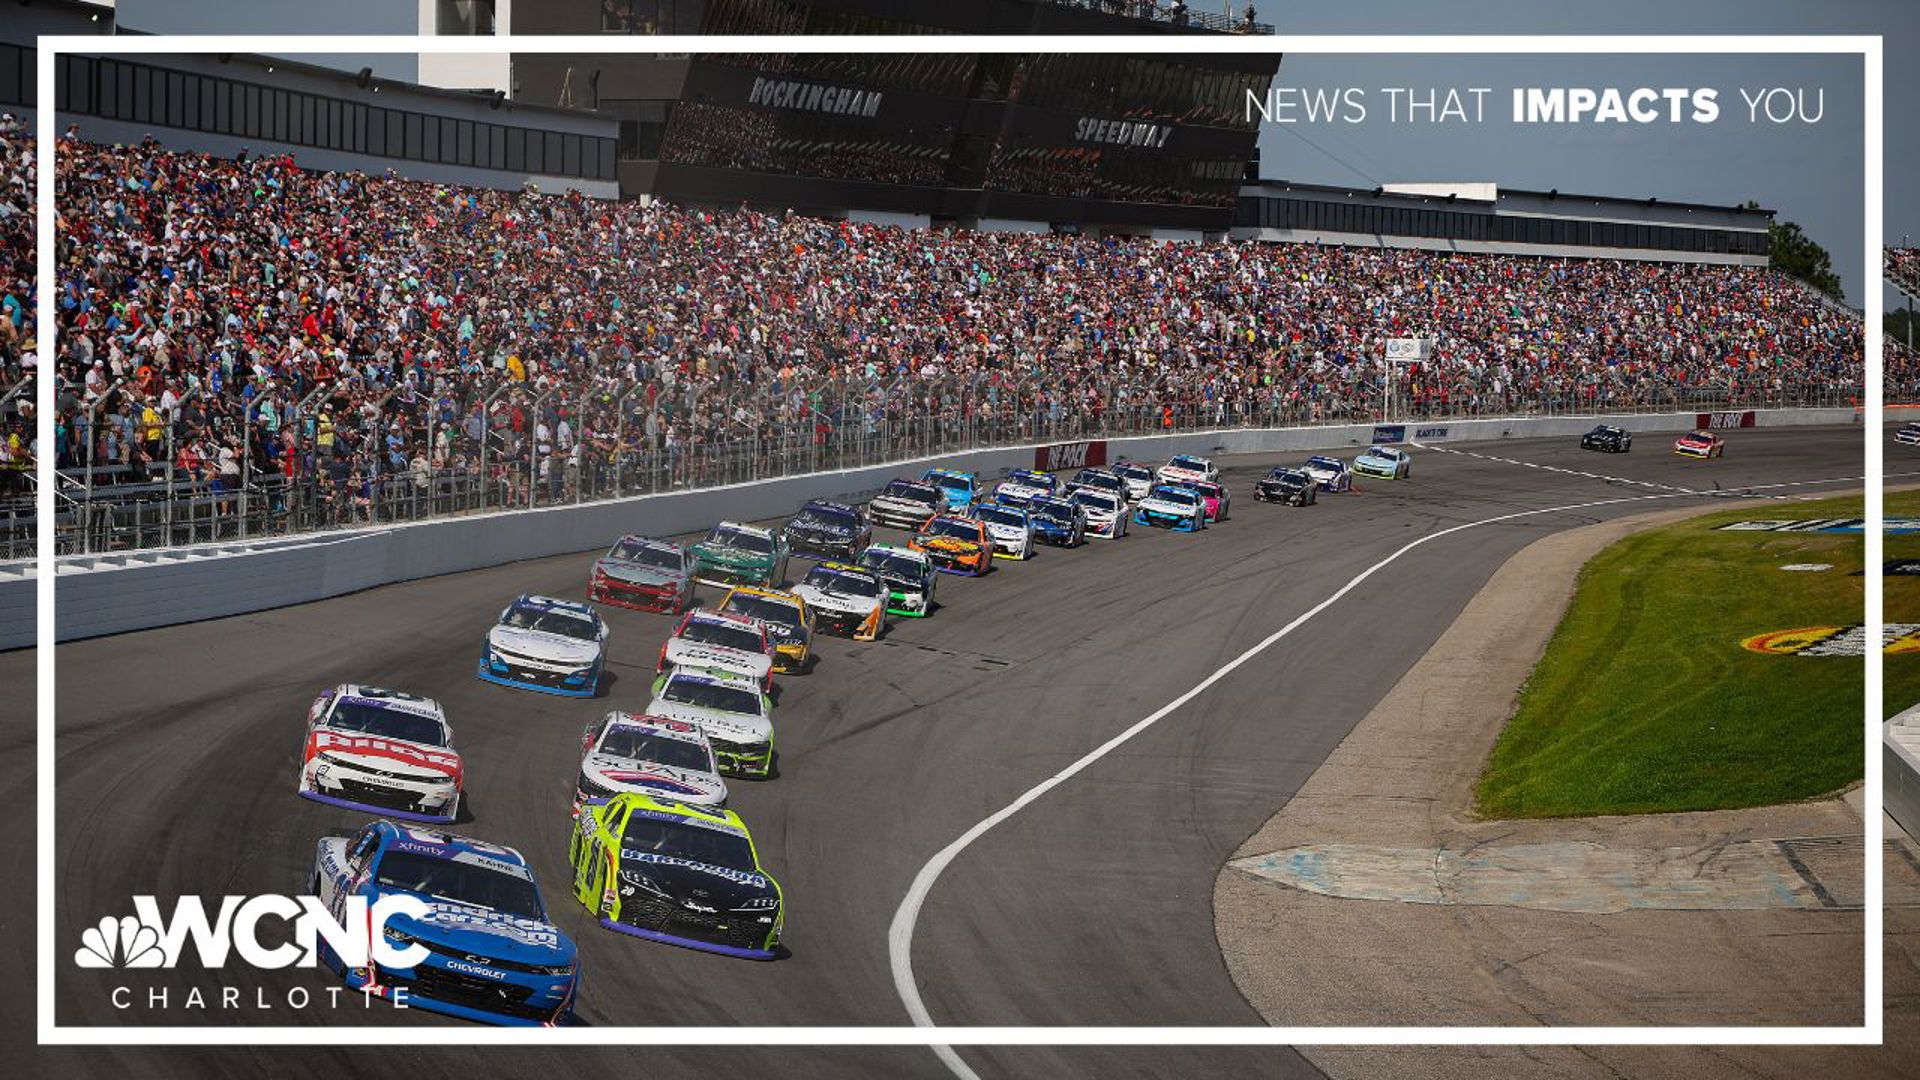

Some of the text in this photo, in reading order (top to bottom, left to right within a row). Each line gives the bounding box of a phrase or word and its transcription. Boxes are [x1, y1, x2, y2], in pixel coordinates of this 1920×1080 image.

[749, 76, 882, 117] ROCKINGHAM
[1075, 117, 1173, 147] SPEEDWAY
[398, 841, 445, 856] xfinity
[477, 857, 514, 873] KAHNE
[620, 885, 636, 897] 20
[446, 960, 508, 981] CHEVROLET
